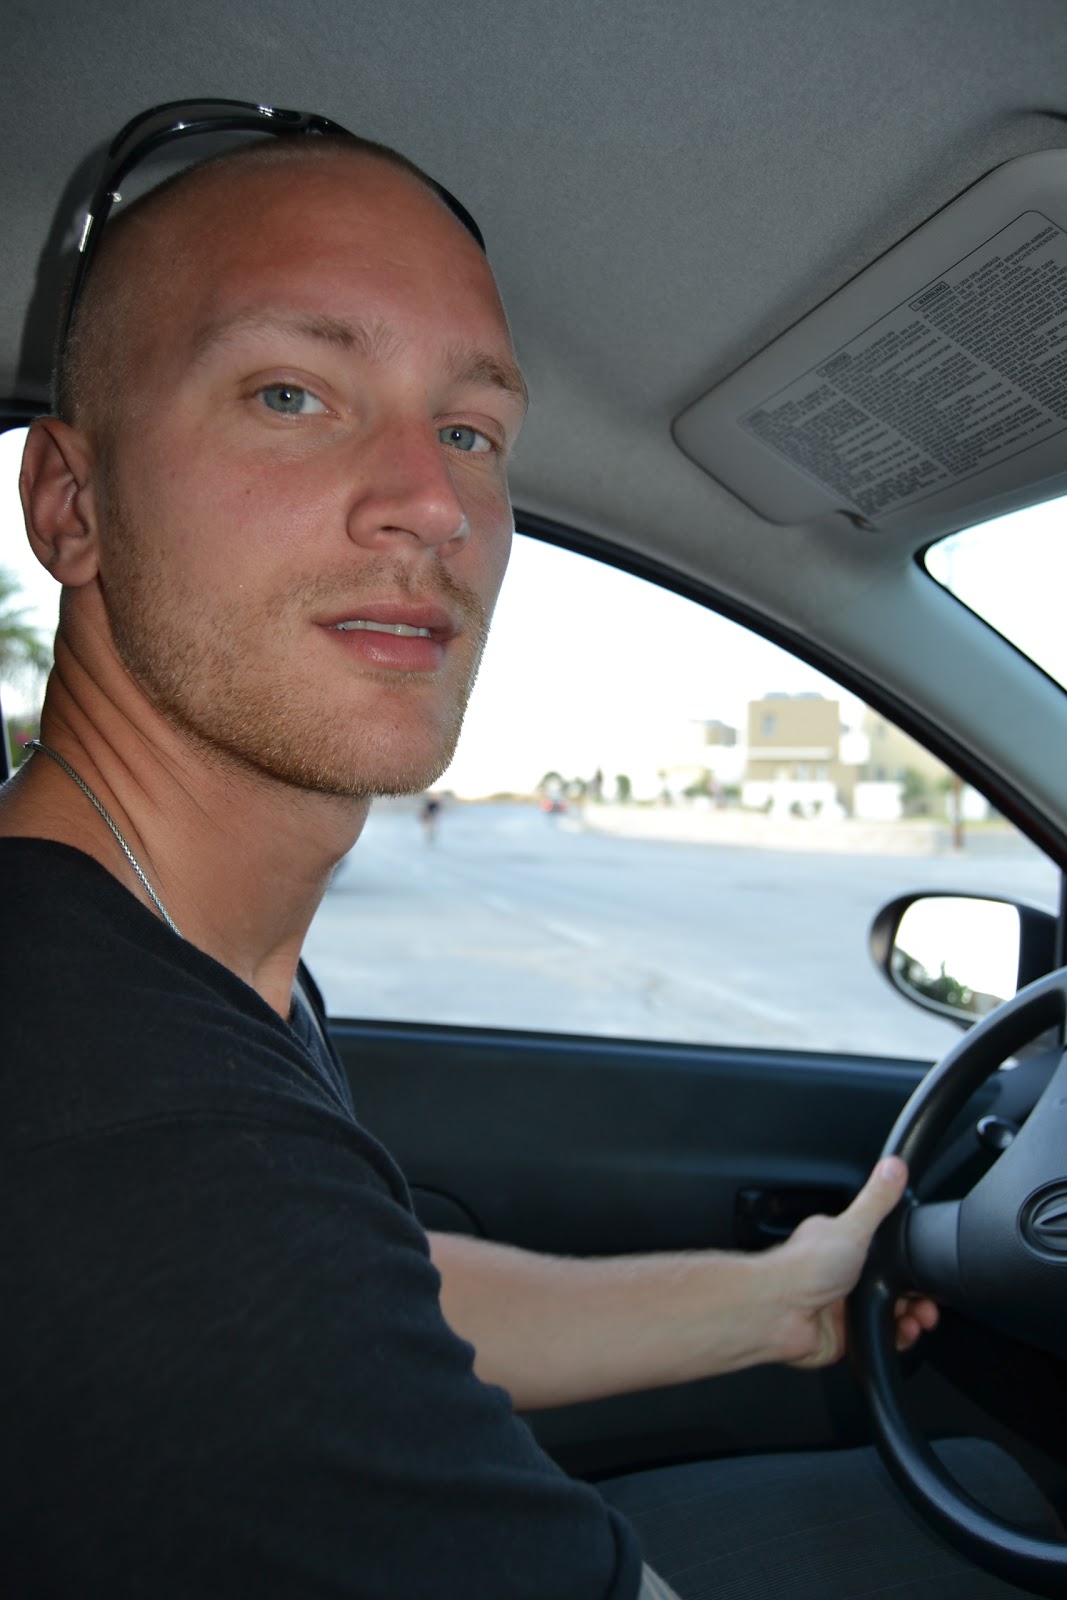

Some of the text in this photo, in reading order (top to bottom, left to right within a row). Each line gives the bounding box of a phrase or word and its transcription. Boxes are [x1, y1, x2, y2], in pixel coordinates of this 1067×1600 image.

[1000, 265, 1011, 273] DIE
[1031, 268, 1043, 276] MIT
[1041, 260, 1055, 269] DEM
[917, 284, 946, 305] WARNUNG
[978, 279, 1003, 297] BEACHTET
[1025, 285, 1053, 304] ANGELEGT
[1002, 290, 1022, 304] DIESEM
